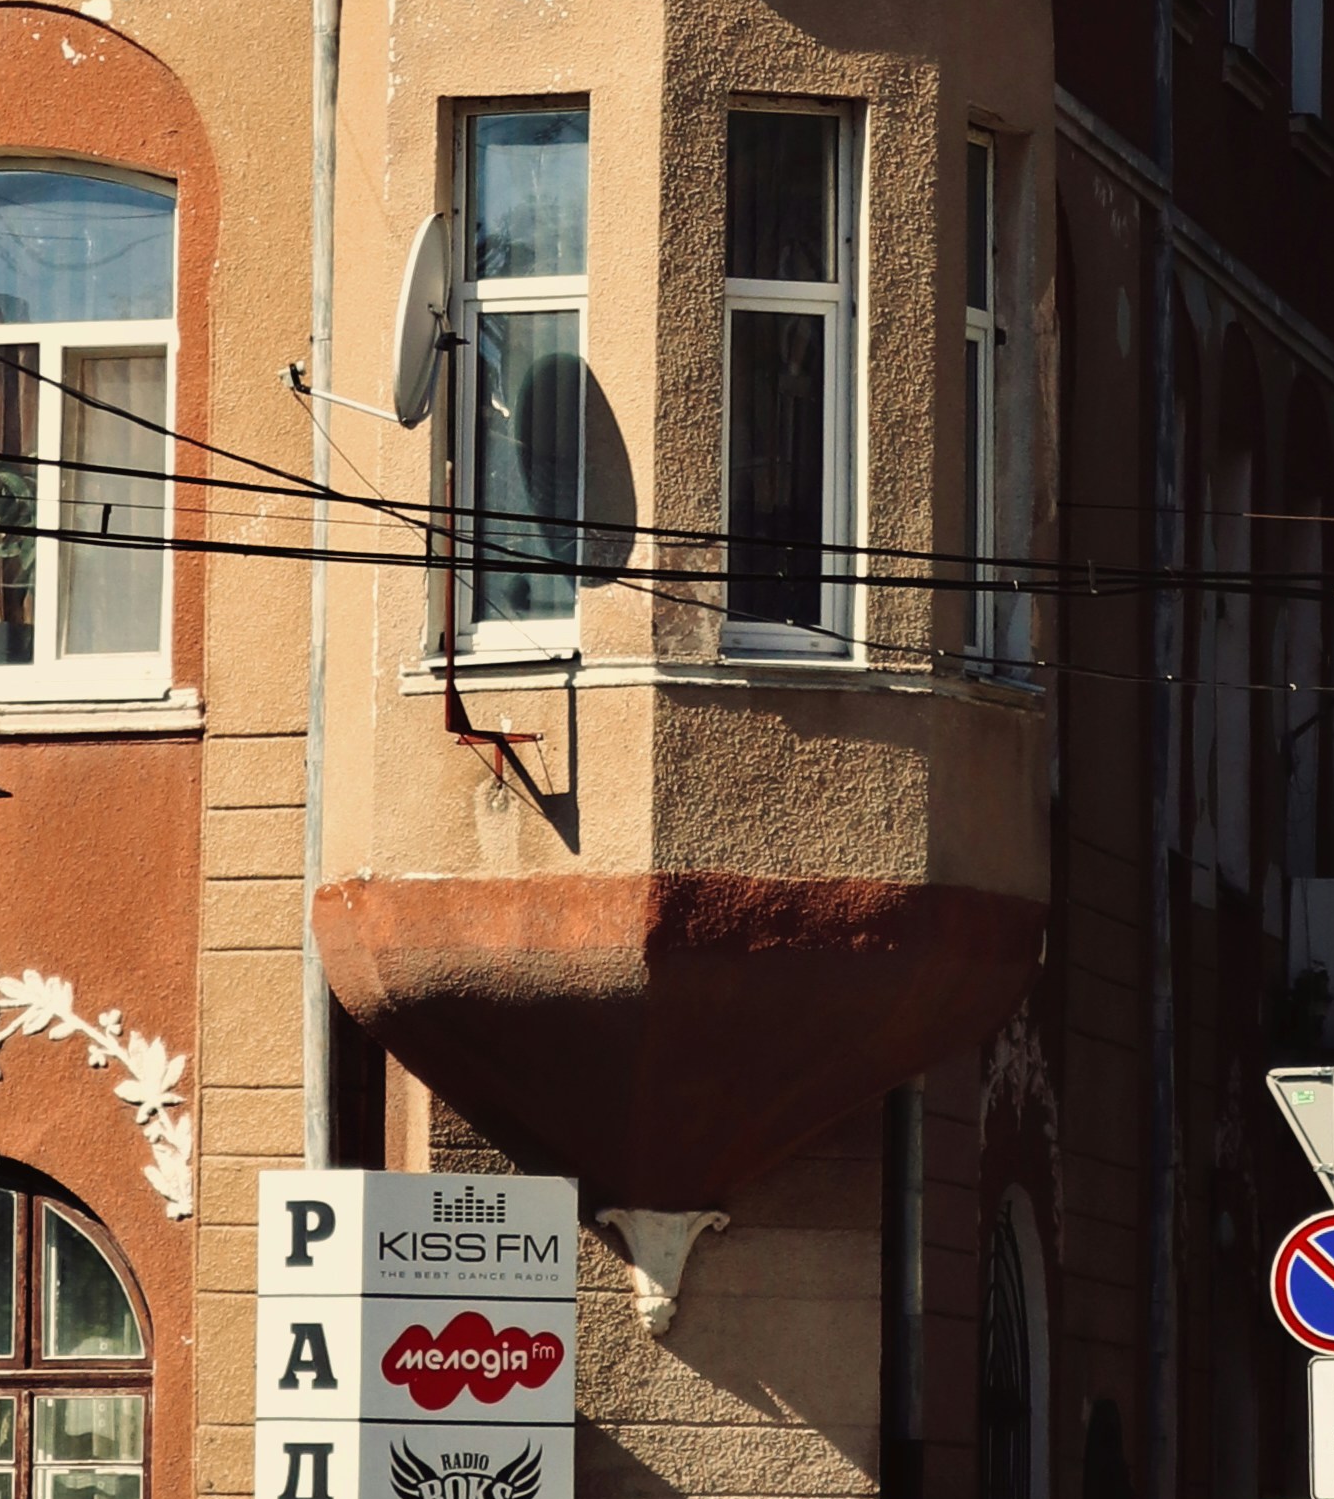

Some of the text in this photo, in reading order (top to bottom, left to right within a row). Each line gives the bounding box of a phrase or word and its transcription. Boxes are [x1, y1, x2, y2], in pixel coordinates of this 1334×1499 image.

[379, 1231, 558, 1263] KISS FM
[380, 1271, 559, 1282] THE BEST DANCE RADIO
[395, 1341, 555, 1379] мелодія fm
[440, 1452, 490, 1471] RADIO
